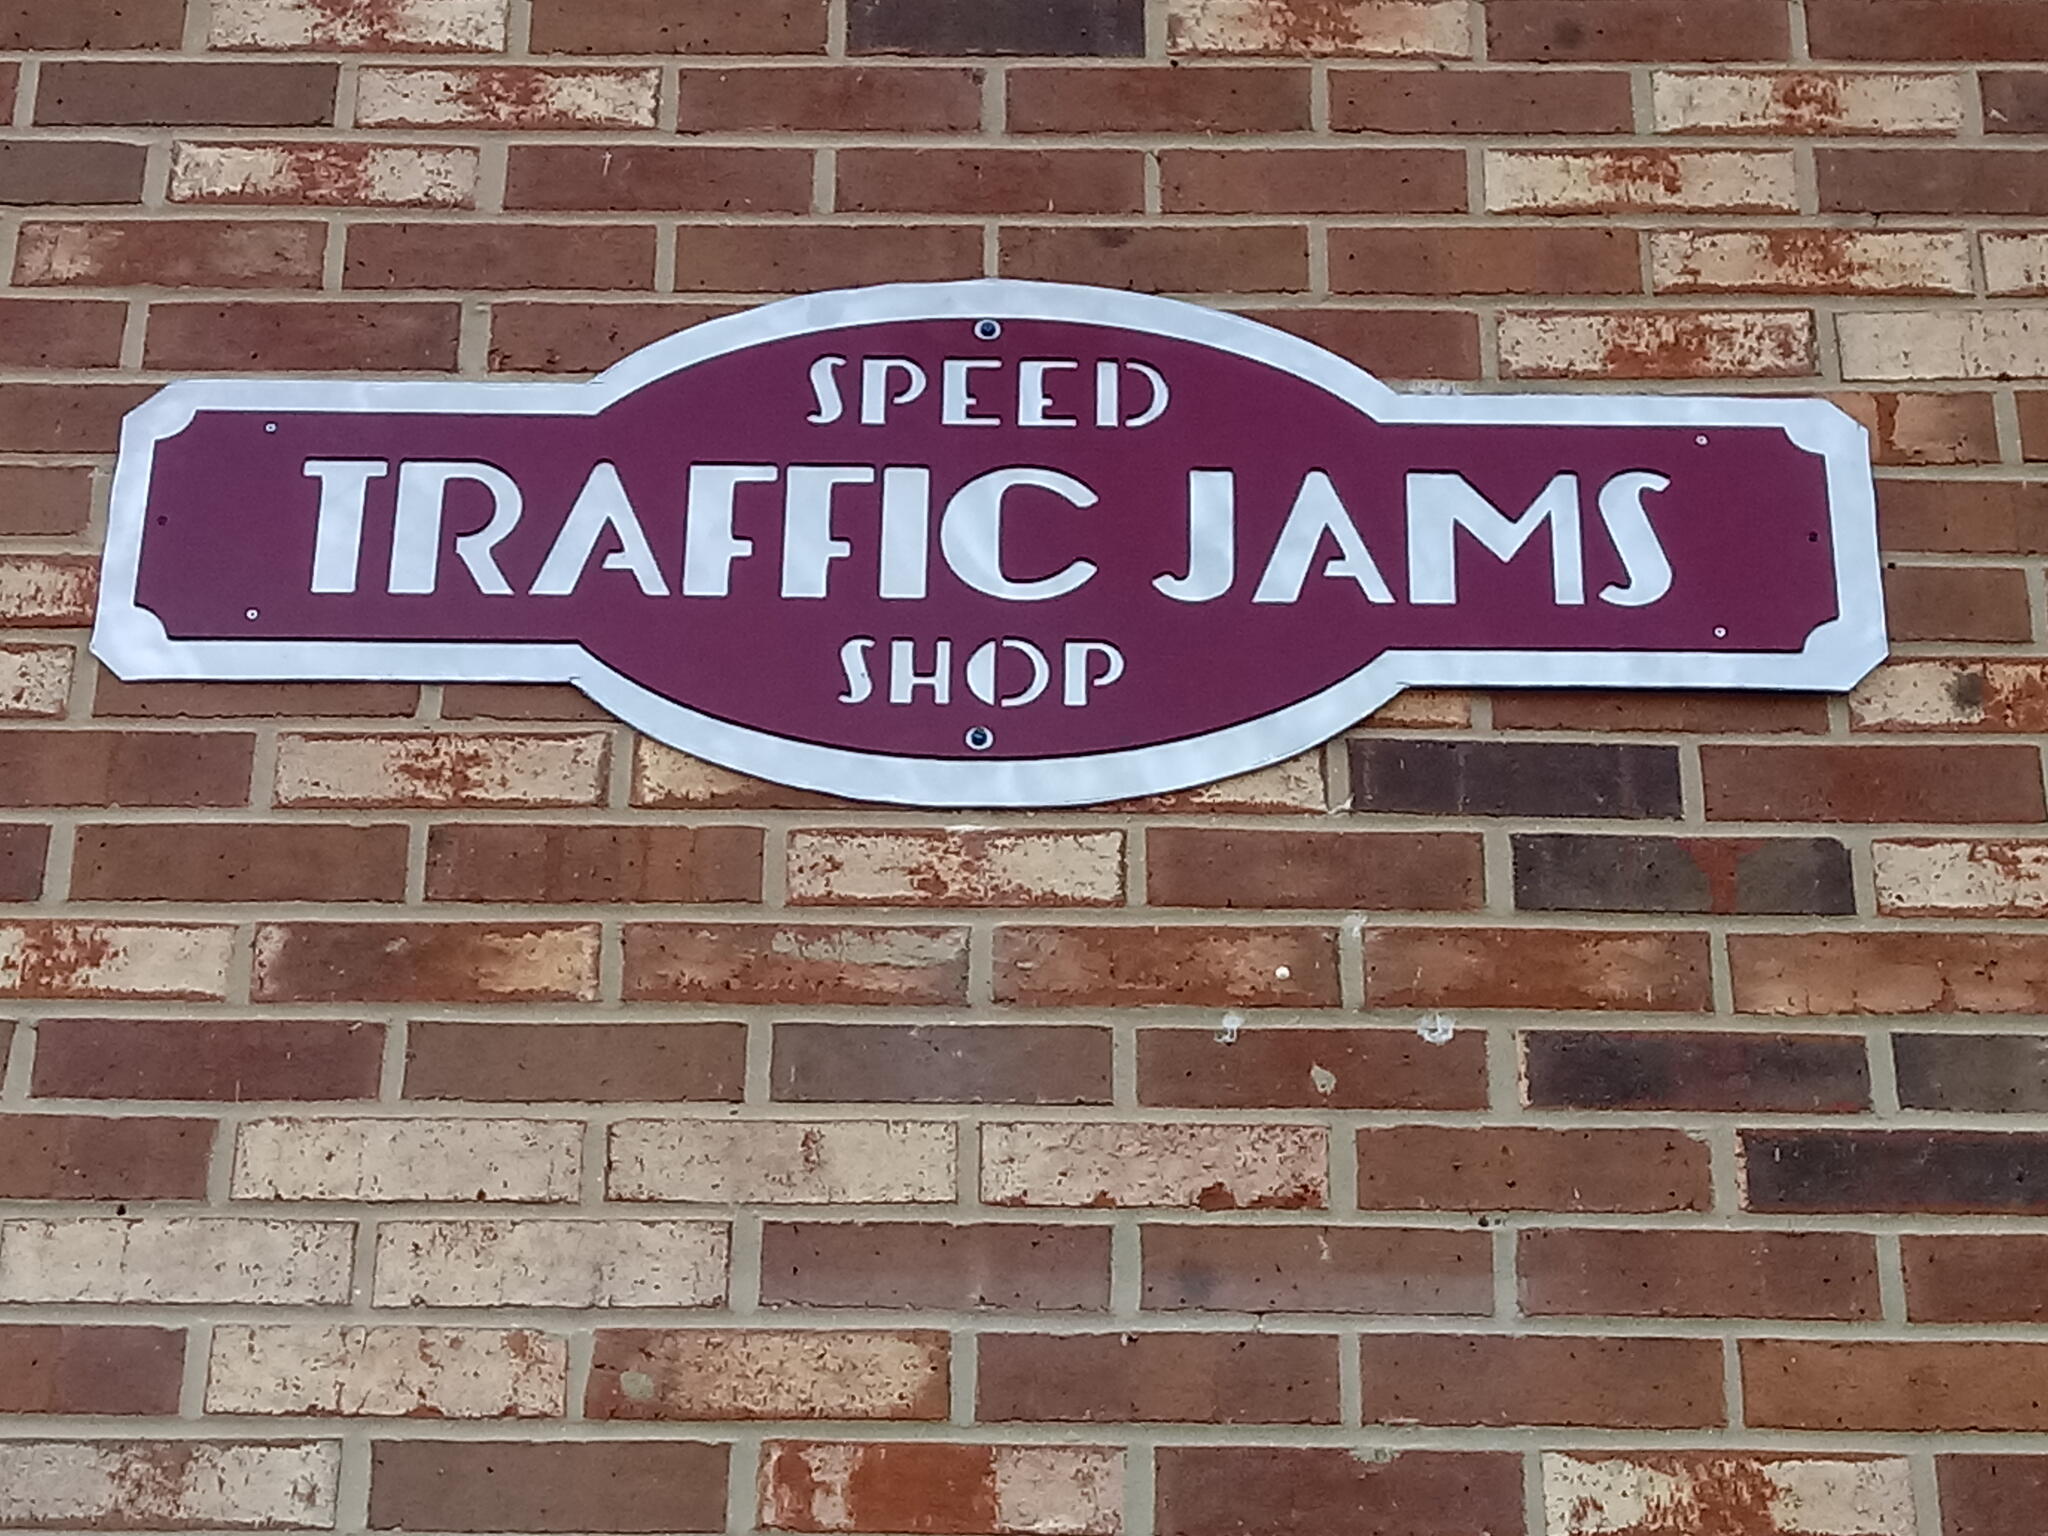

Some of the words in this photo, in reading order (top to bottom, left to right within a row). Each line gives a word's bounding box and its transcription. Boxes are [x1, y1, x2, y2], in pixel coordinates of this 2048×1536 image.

[806, 356, 1170, 428] SPEED
[303, 460, 1099, 601] TRAFFIC
[1152, 470, 1673, 607] JAMS
[838, 639, 1125, 708] SHOP
